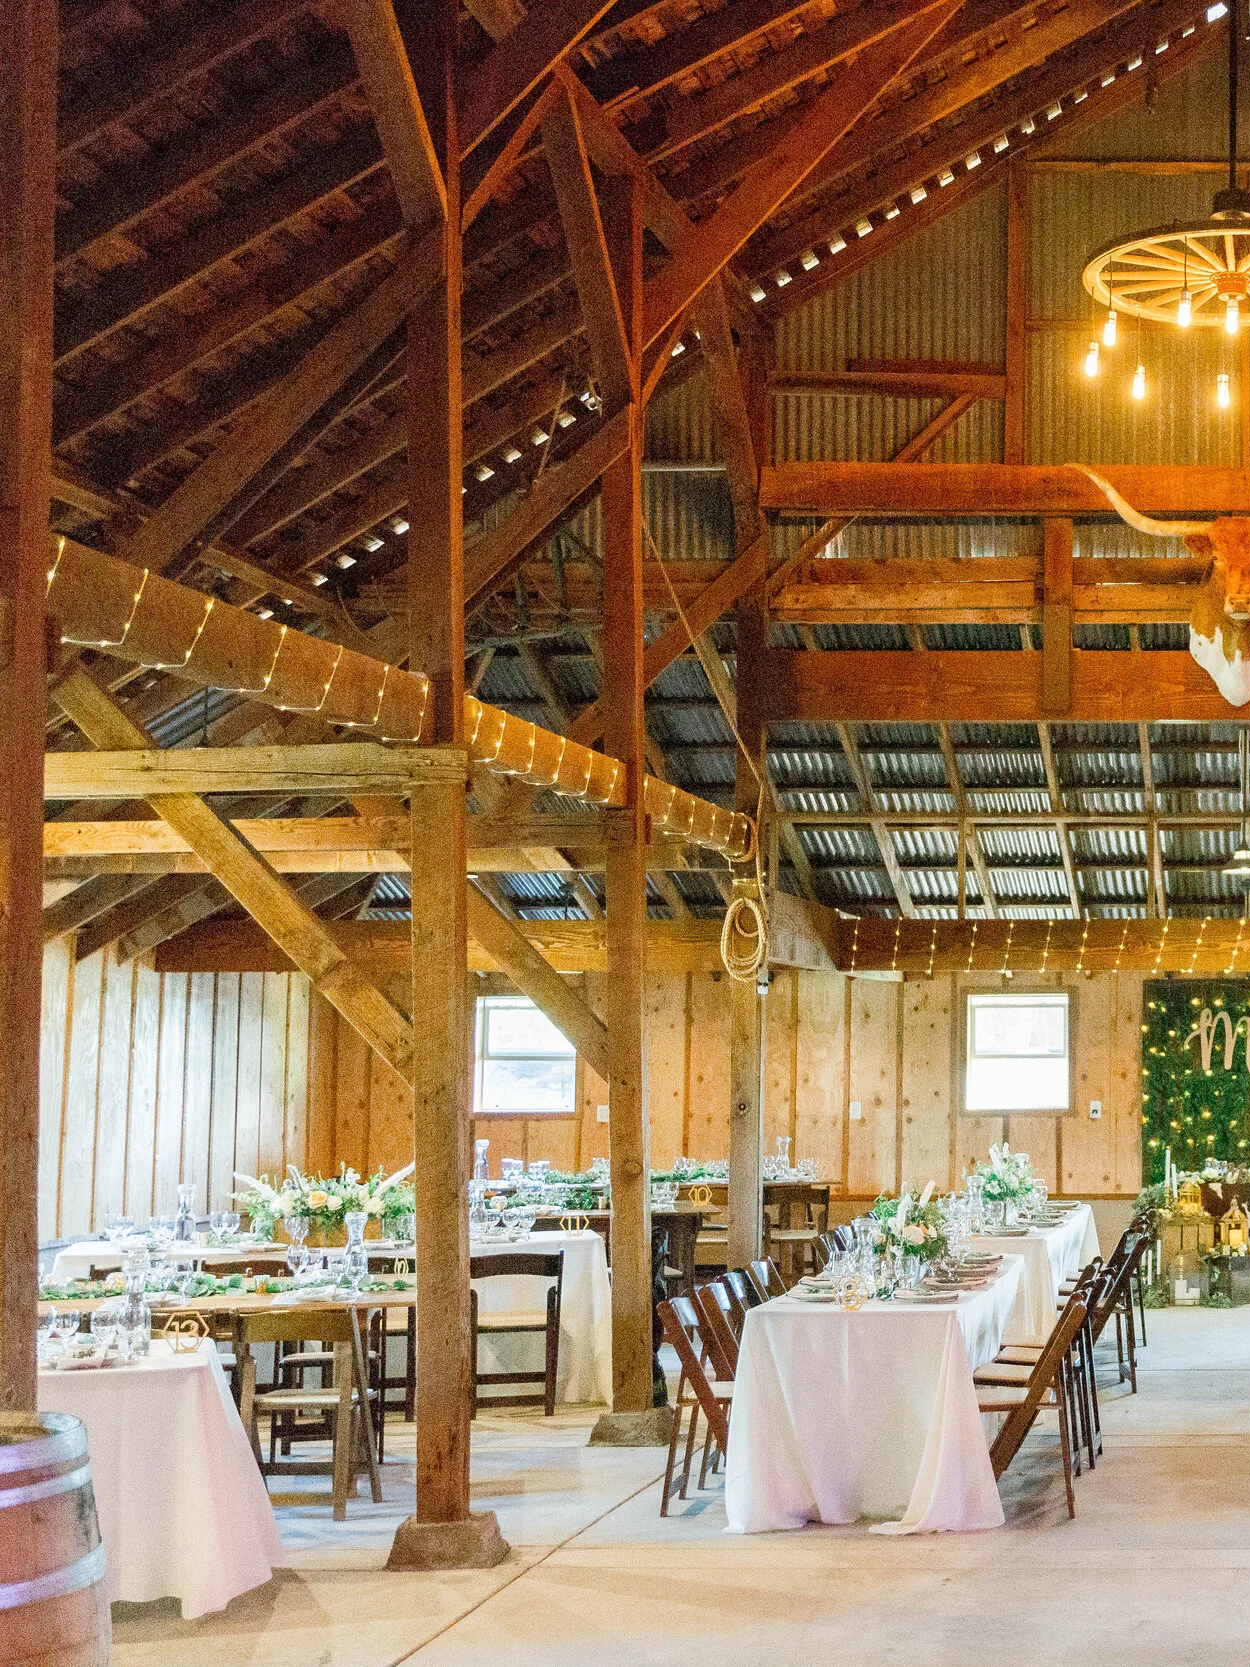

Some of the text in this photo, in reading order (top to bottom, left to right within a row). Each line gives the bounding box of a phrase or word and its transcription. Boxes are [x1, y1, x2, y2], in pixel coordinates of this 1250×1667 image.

[692, 1187, 709, 1205] 10
[565, 1216, 580, 1236] 11
[843, 1281, 859, 1310] 8
[170, 1320, 199, 1351] 13
